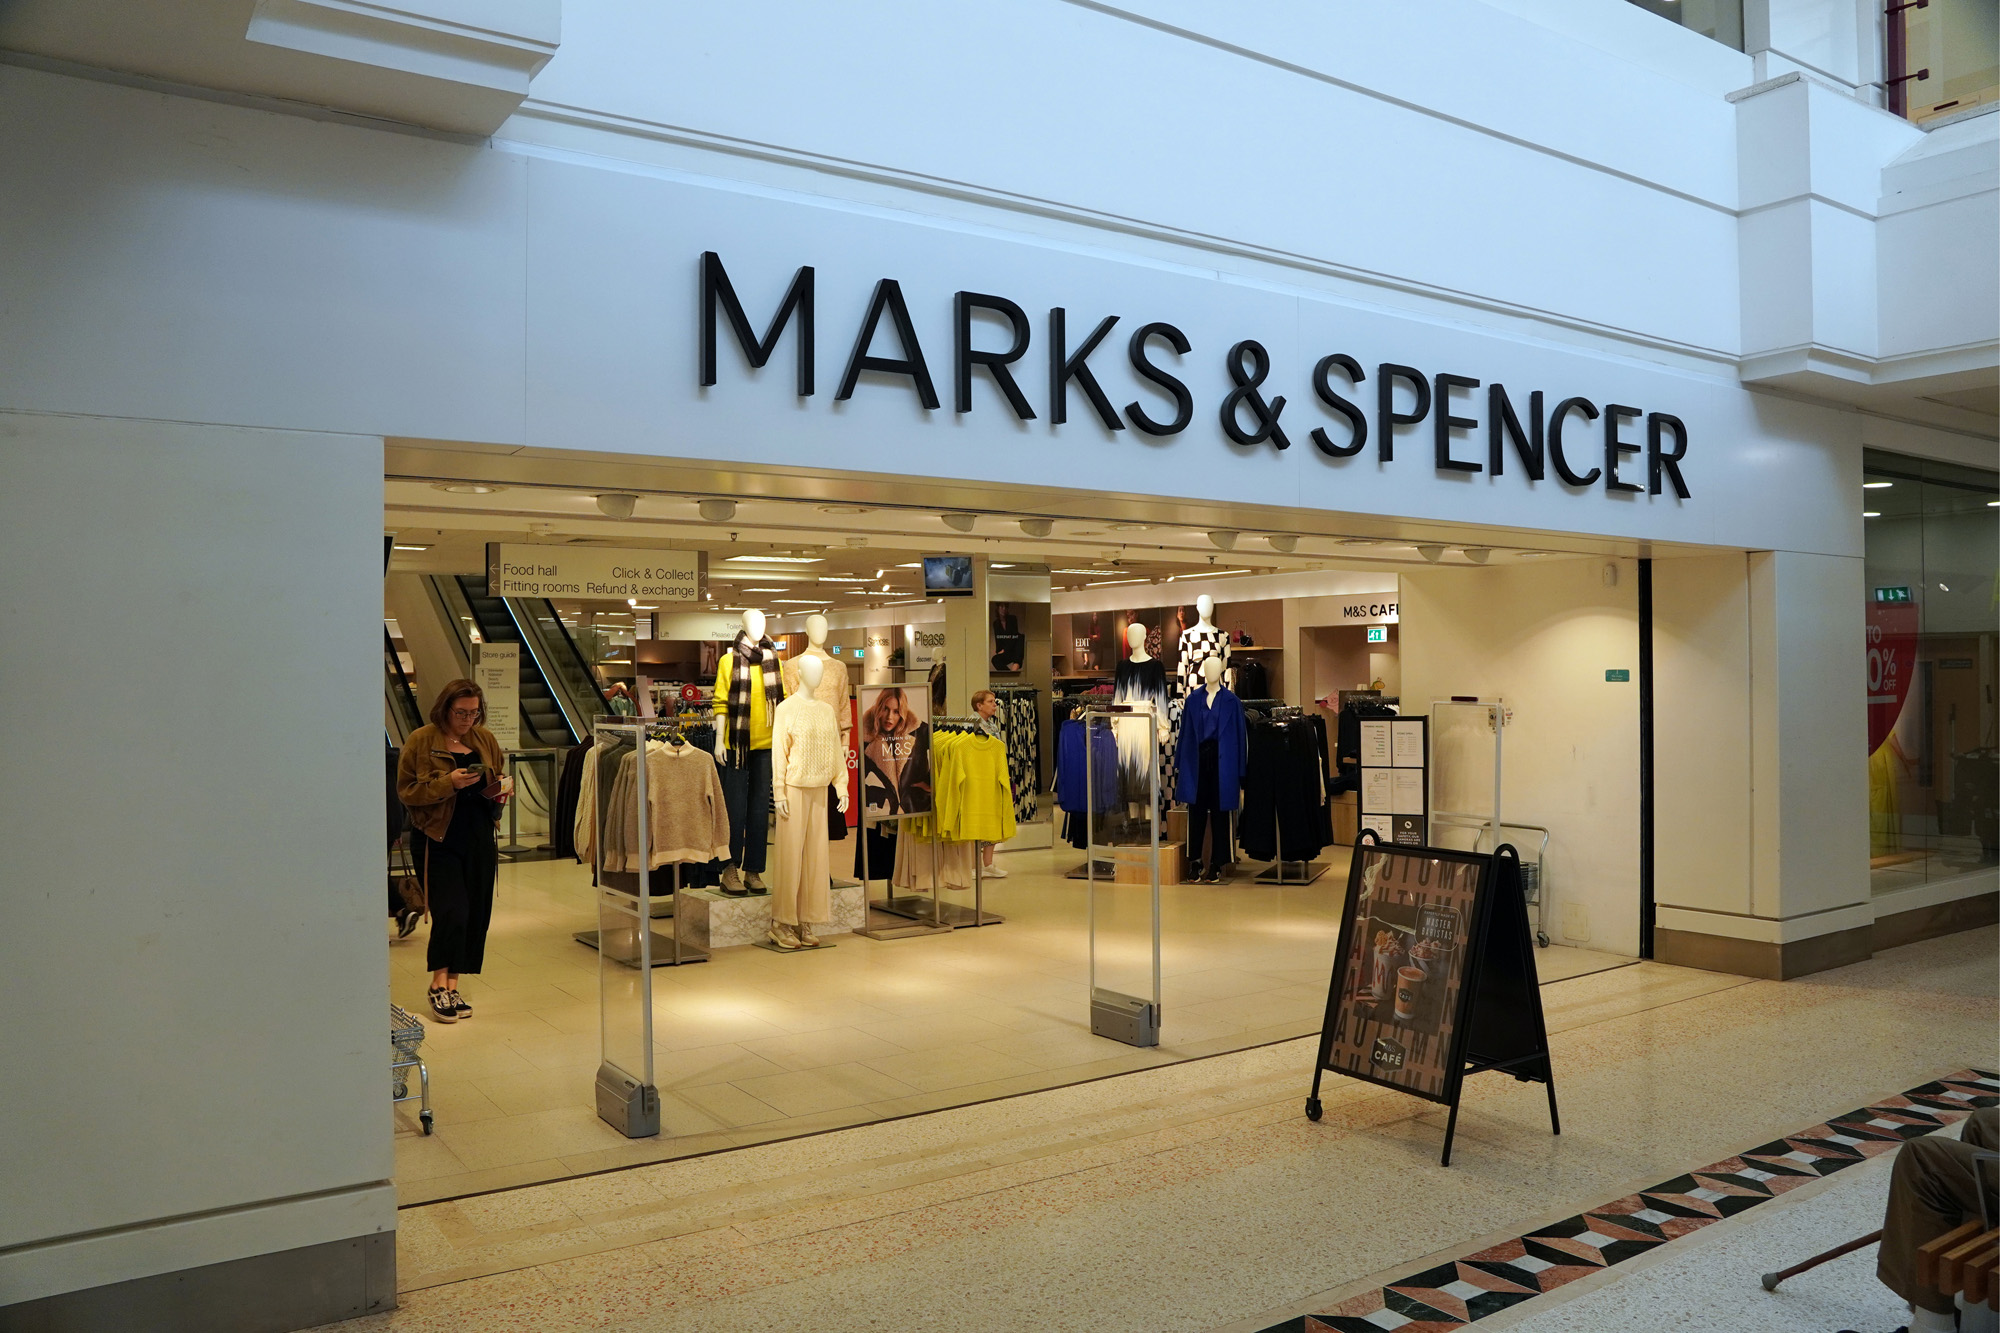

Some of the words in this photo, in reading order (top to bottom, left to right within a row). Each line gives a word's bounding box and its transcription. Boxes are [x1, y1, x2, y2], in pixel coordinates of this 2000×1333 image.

[700, 251, 1193, 436] MARKS
[1220, 340, 1290, 450] &
[1311, 354, 1691, 498] SPENCER
[503, 563, 535, 576] Food
[537, 564, 558, 577] hall
[612, 566, 641, 579] Click
[644, 567, 653, 579] &
[655, 568, 695, 581] Collect
[503, 579, 540, 595] Fitting
[542, 582, 581, 593] rooms
[586, 582, 628, 594] Refund
[630, 583, 639, 595] &
[641, 584, 696, 598] exchange
[1343, 605, 1367, 618] M&S
[914, 630, 946, 648] Please
[482, 651, 498, 659] Store
[499, 652, 518, 660] guide
[1883, 680, 1897, 691] OFF
[881, 742, 912, 757] M&S
[1426, 917, 1452, 930] MASTER
[1421, 927, 1453, 941] BARISTAS
[1374, 1050, 1402, 1066] CAFÉ
